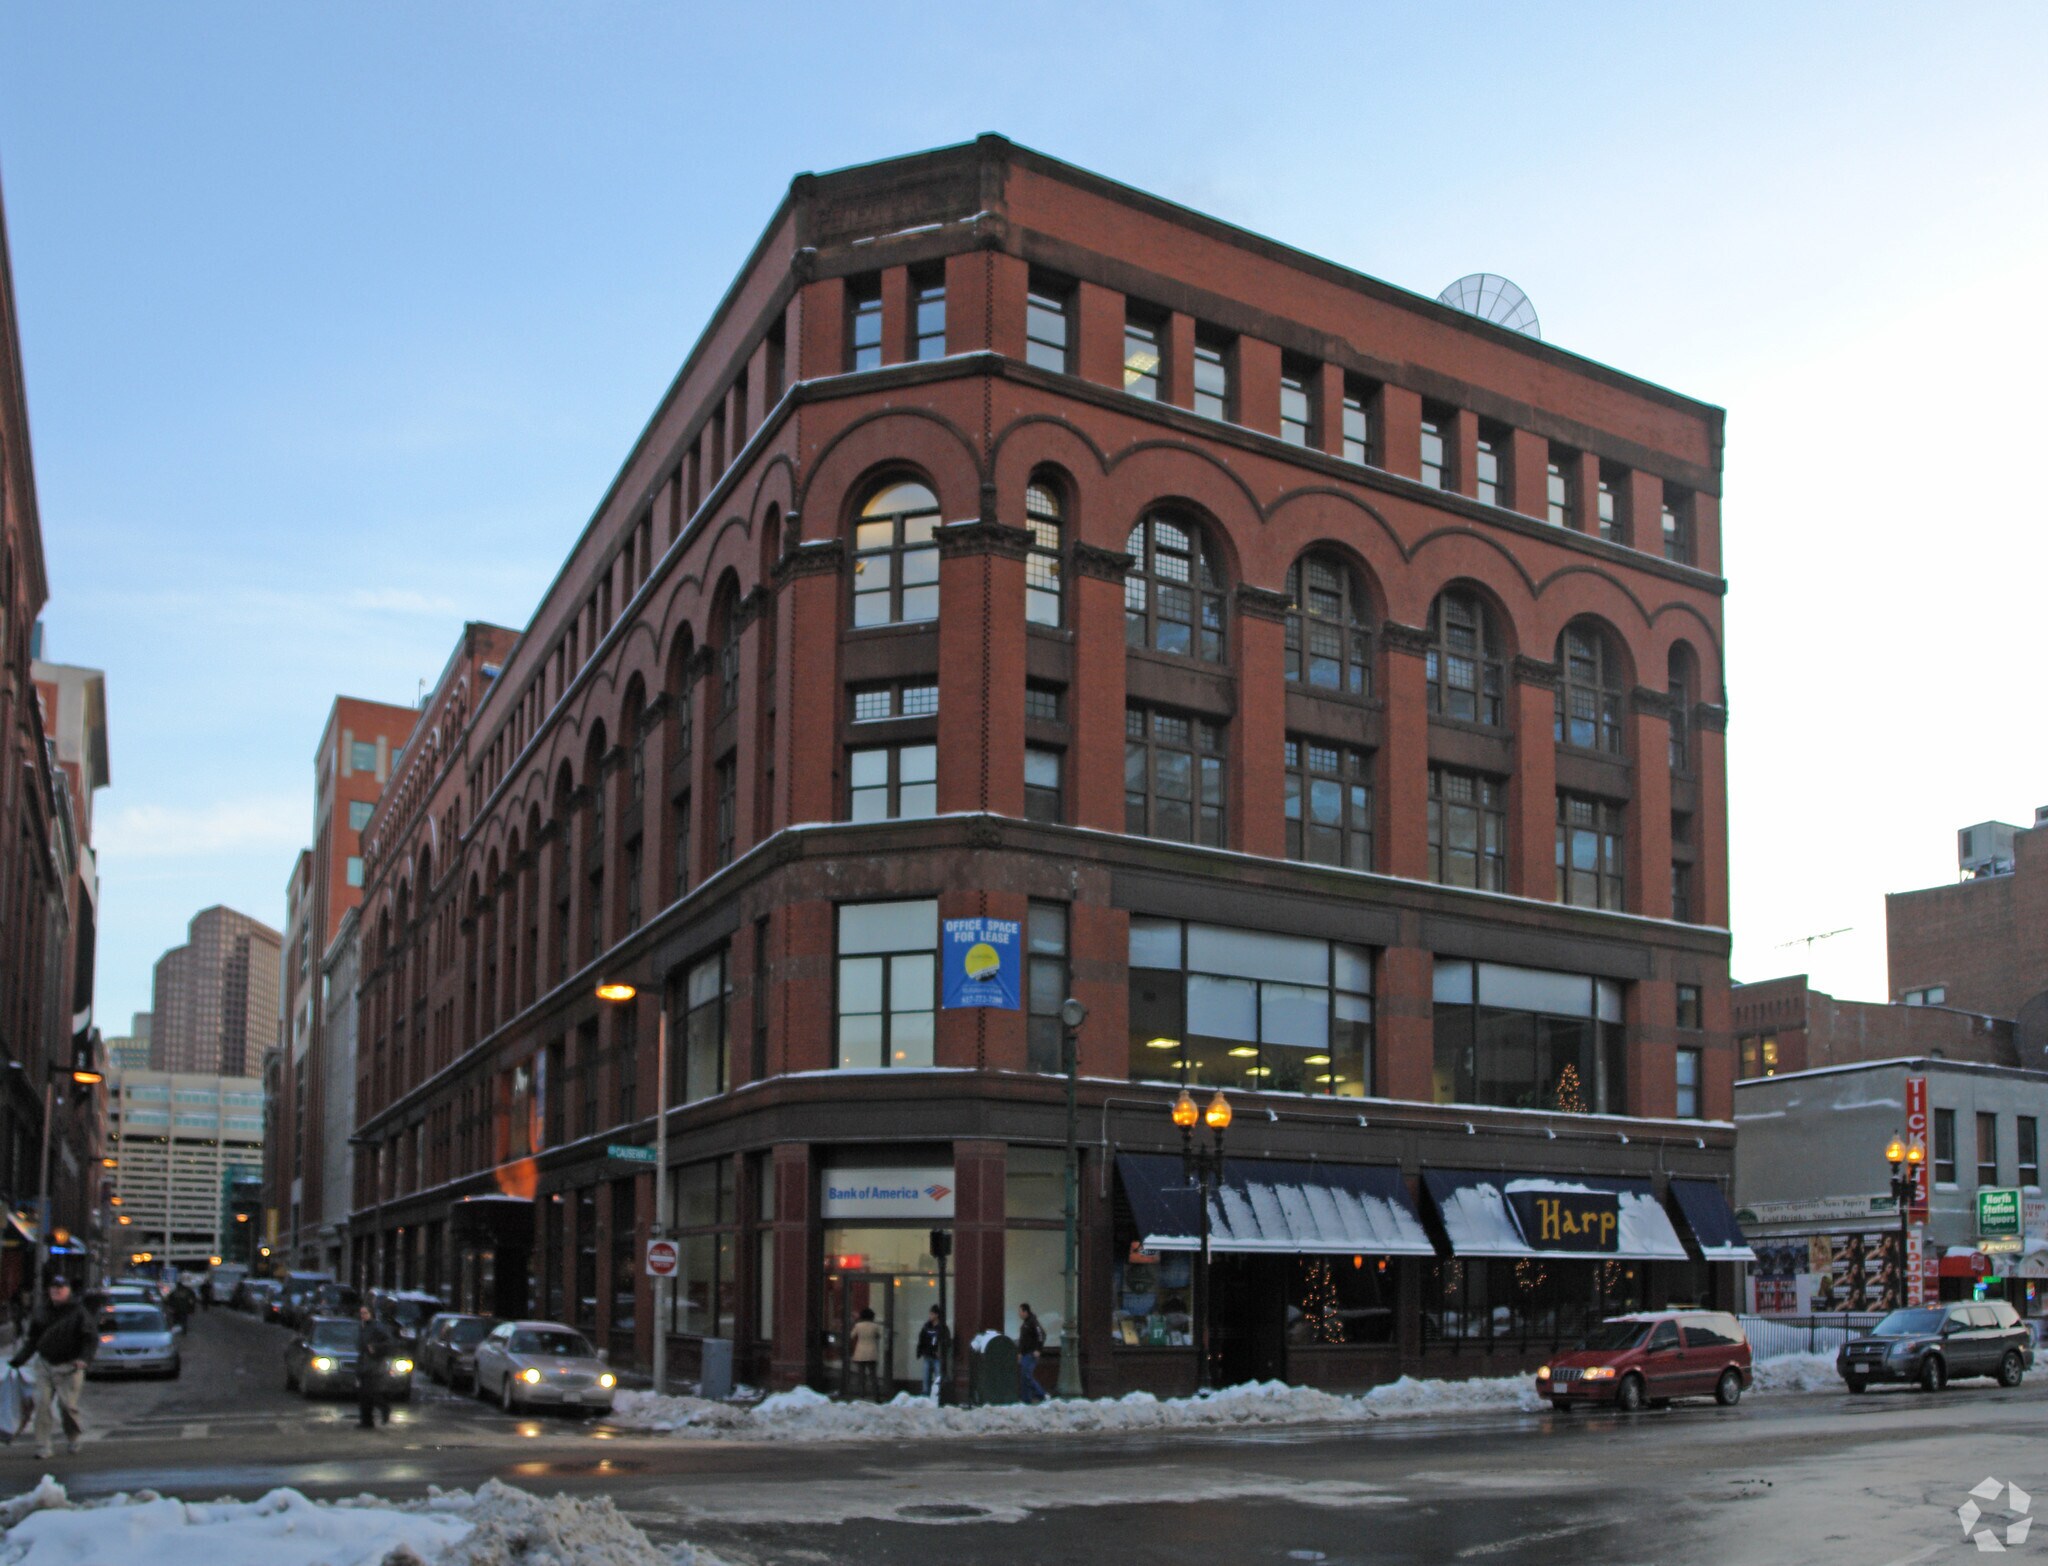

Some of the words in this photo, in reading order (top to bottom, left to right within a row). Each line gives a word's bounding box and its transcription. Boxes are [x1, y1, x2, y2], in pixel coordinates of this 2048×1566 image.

[946, 920, 981, 932] OFFICE
[987, 921, 1018, 934] SPACE
[954, 931, 975, 942] FOR
[980, 931, 1009, 944] LEASE
[1908, 1078, 1926, 1201] TICKTS
[829, 1187, 857, 1200] Bank
[859, 1187, 870, 1200] of
[872, 1187, 918, 1200] America
[1986, 1193, 2012, 1204] North
[1843, 1199, 1866, 1208] Papers
[1983, 1204, 2015, 1215] Station
[1536, 1199, 1617, 1245] Harp
[1983, 1215, 2016, 1225] Liquors
